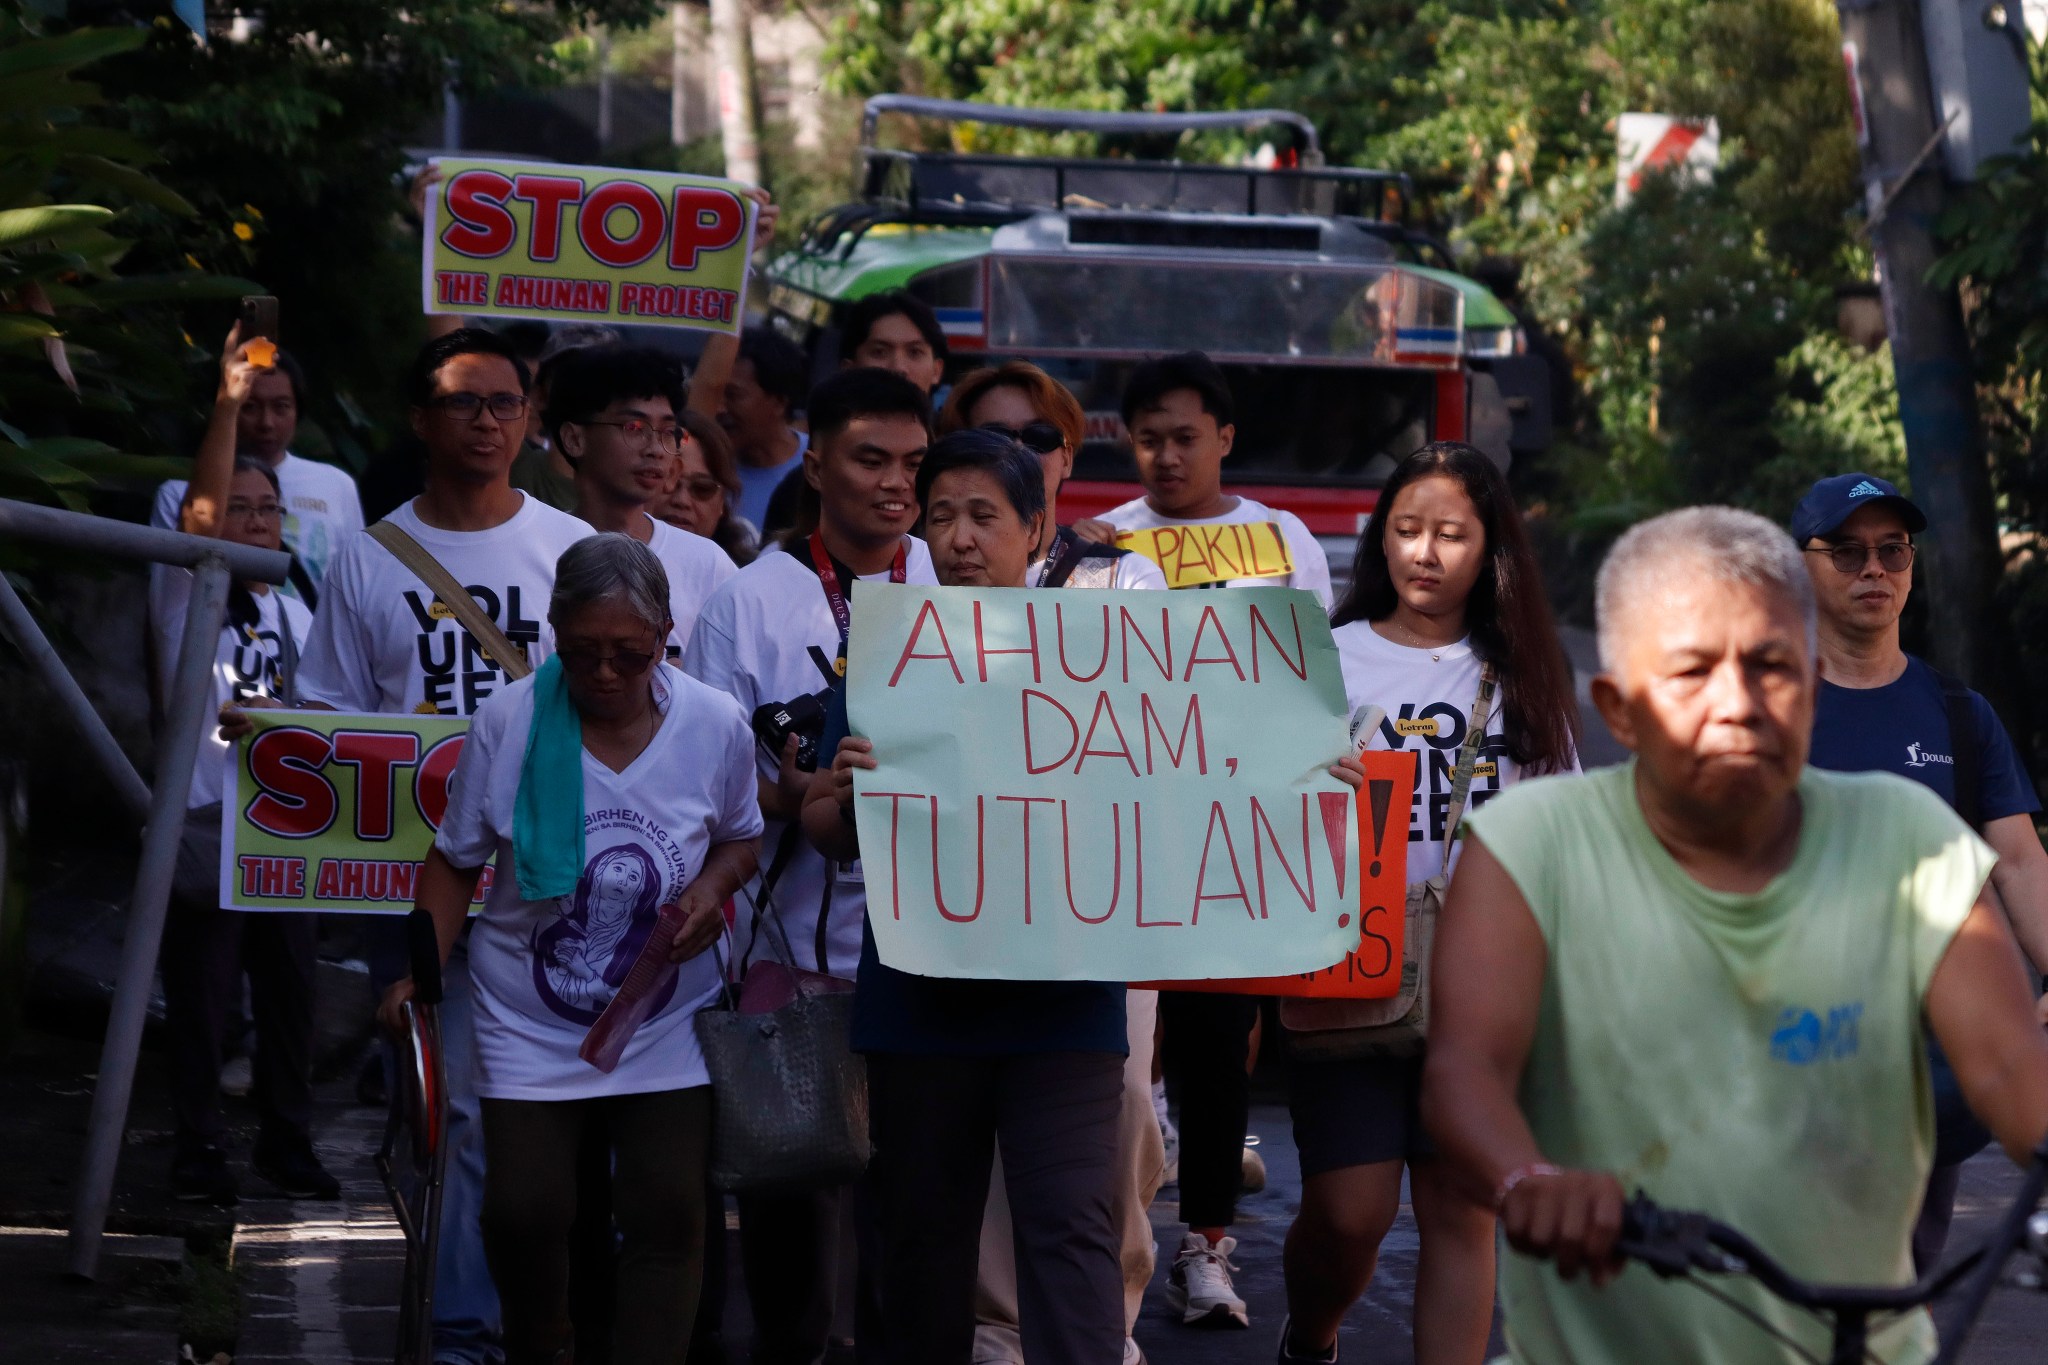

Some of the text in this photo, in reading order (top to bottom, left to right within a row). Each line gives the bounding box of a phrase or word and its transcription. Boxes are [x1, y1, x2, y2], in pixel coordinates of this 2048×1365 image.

[441, 170, 745, 270] STOP
[436, 271, 738, 323] THE AHUNAN PROJECT
[1849, 489, 1885, 498] adidas
[1152, 521, 1292, 582] PAKIL!
[888, 599, 1308, 688] AHUNAN
[1022, 688, 1239, 778] DAM,
[584, 808, 645, 827] BIRHEN
[646, 820, 669, 843] NG
[238, 853, 307, 899] THE
[314, 857, 425, 903] AHUN
[861, 791, 1350, 929] TUTULAN!
